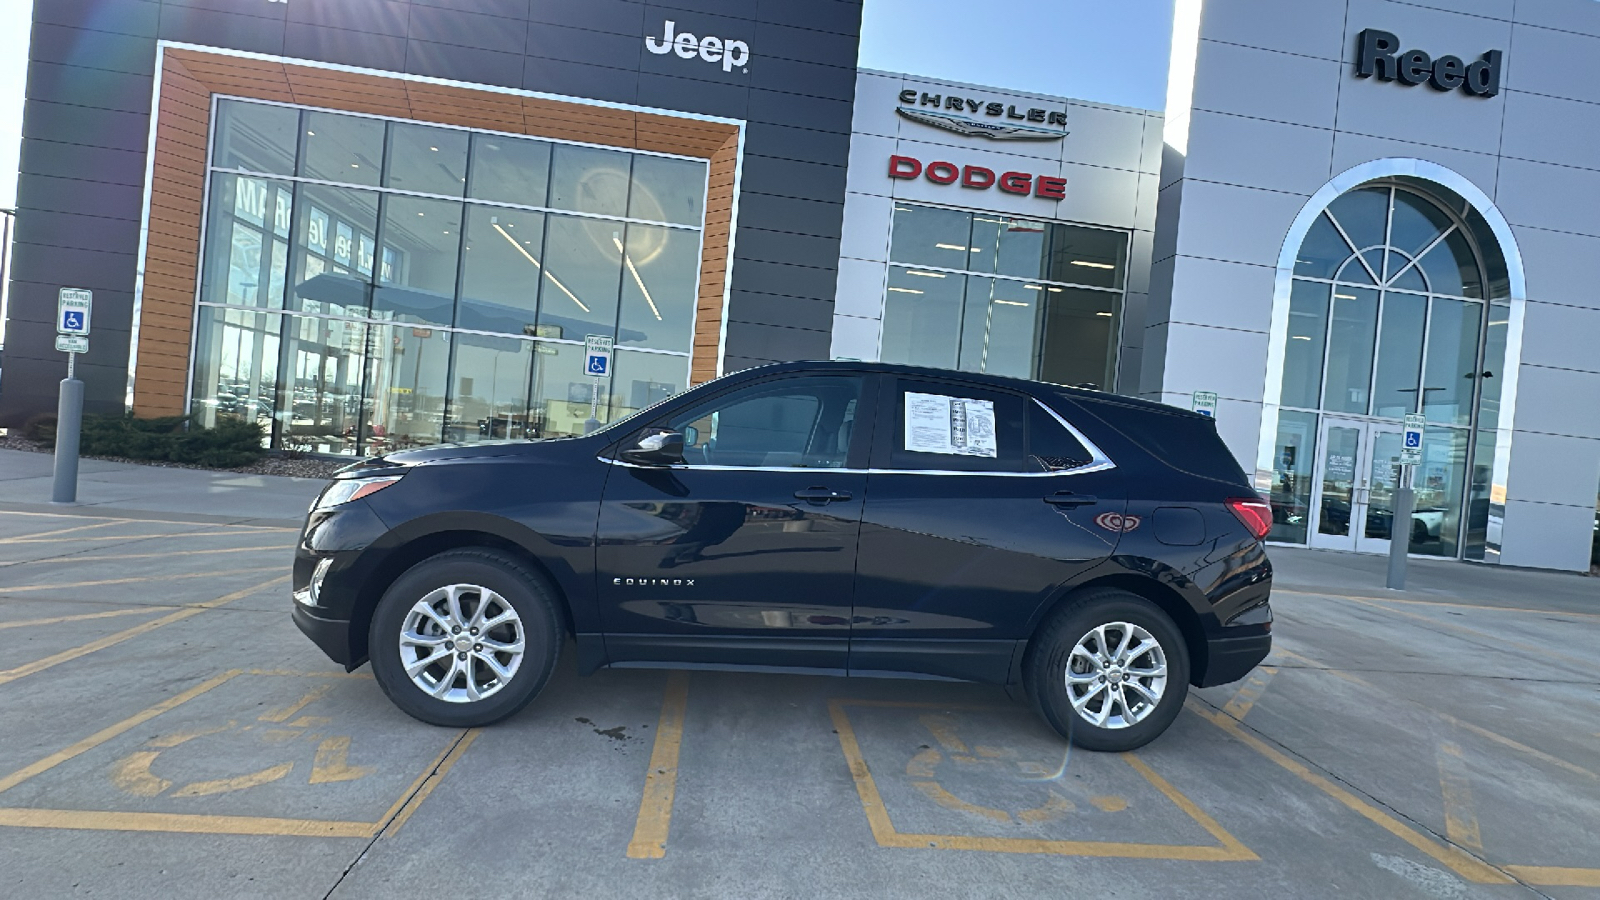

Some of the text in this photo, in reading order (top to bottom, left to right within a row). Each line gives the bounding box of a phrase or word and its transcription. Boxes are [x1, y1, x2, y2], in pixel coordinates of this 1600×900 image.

[645, 20, 749, 72] Jeep
[1356, 28, 1502, 98] Reed
[899, 89, 1068, 125] CHRYSLER
[888, 155, 1067, 200] DODGE
[613, 577, 695, 586] EQUINOX
